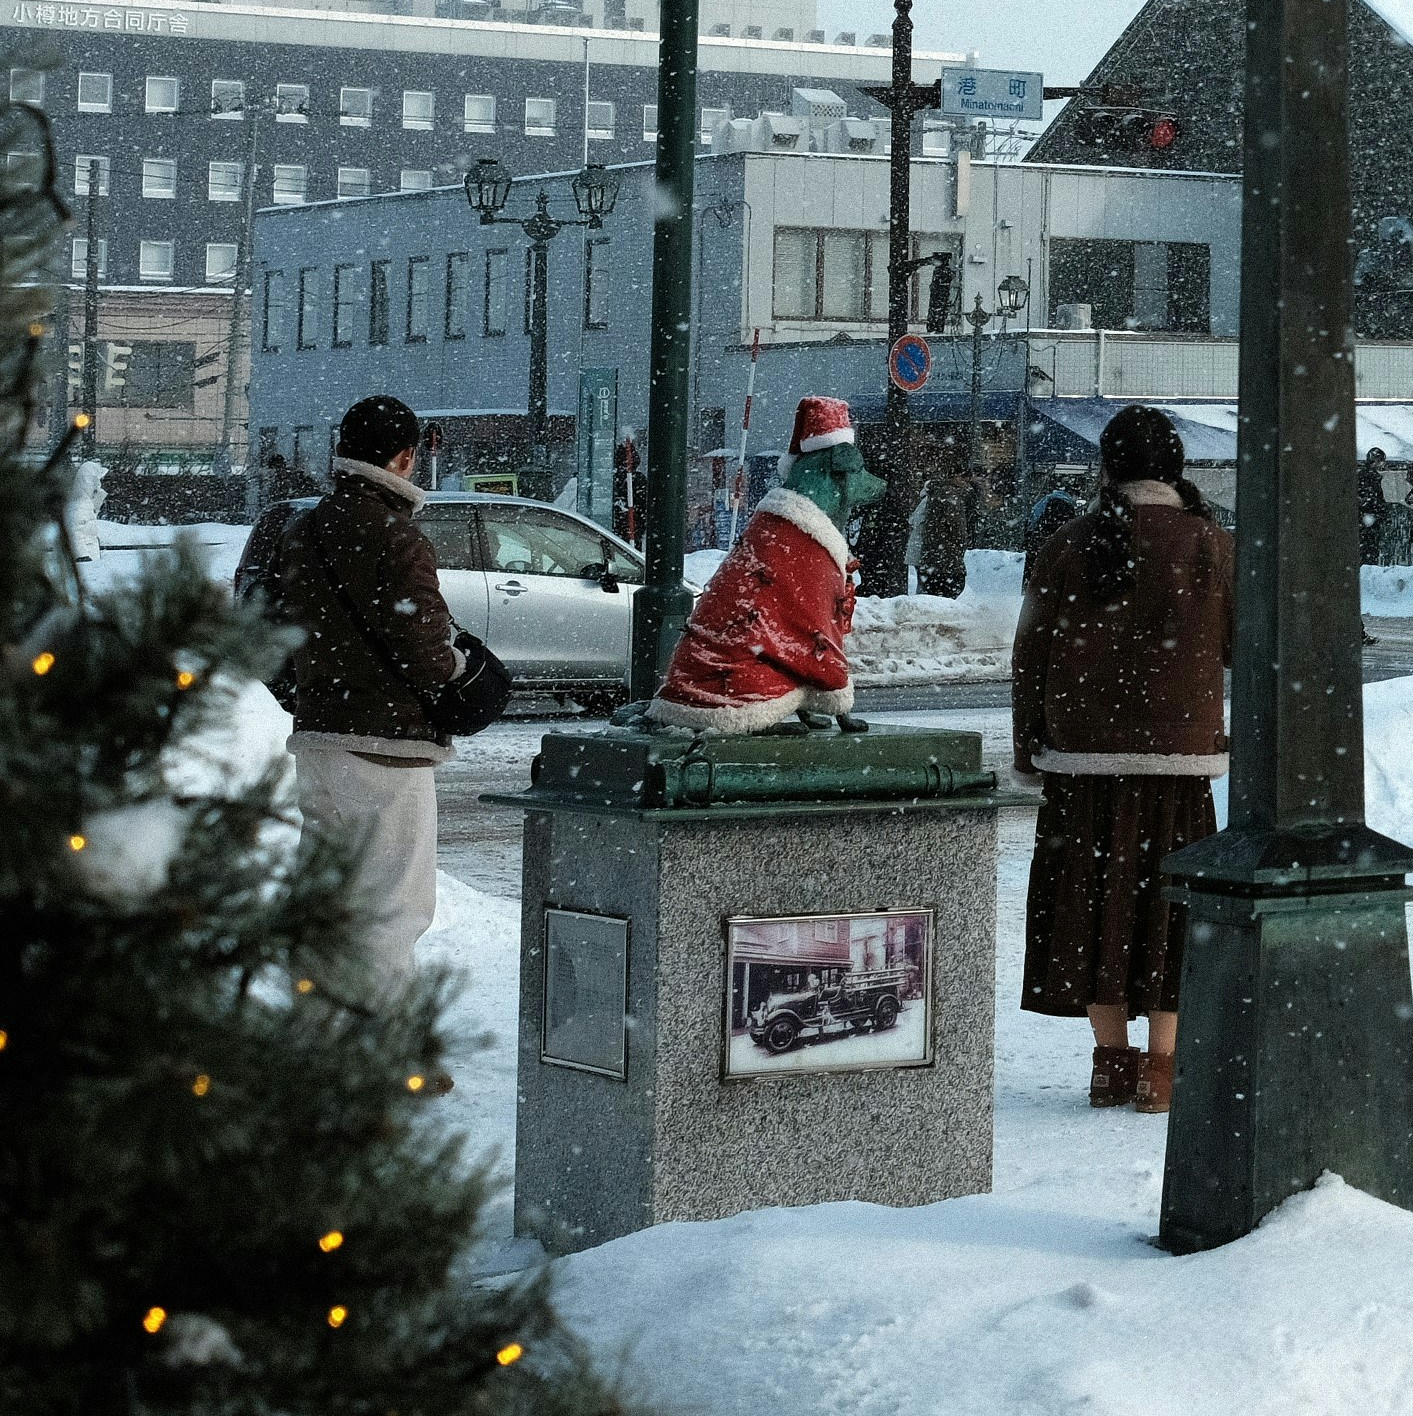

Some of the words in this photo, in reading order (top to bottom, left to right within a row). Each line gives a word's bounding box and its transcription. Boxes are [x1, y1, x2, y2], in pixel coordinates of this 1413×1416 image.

[12, 3, 189, 34] 小樽地方合同庁舎
